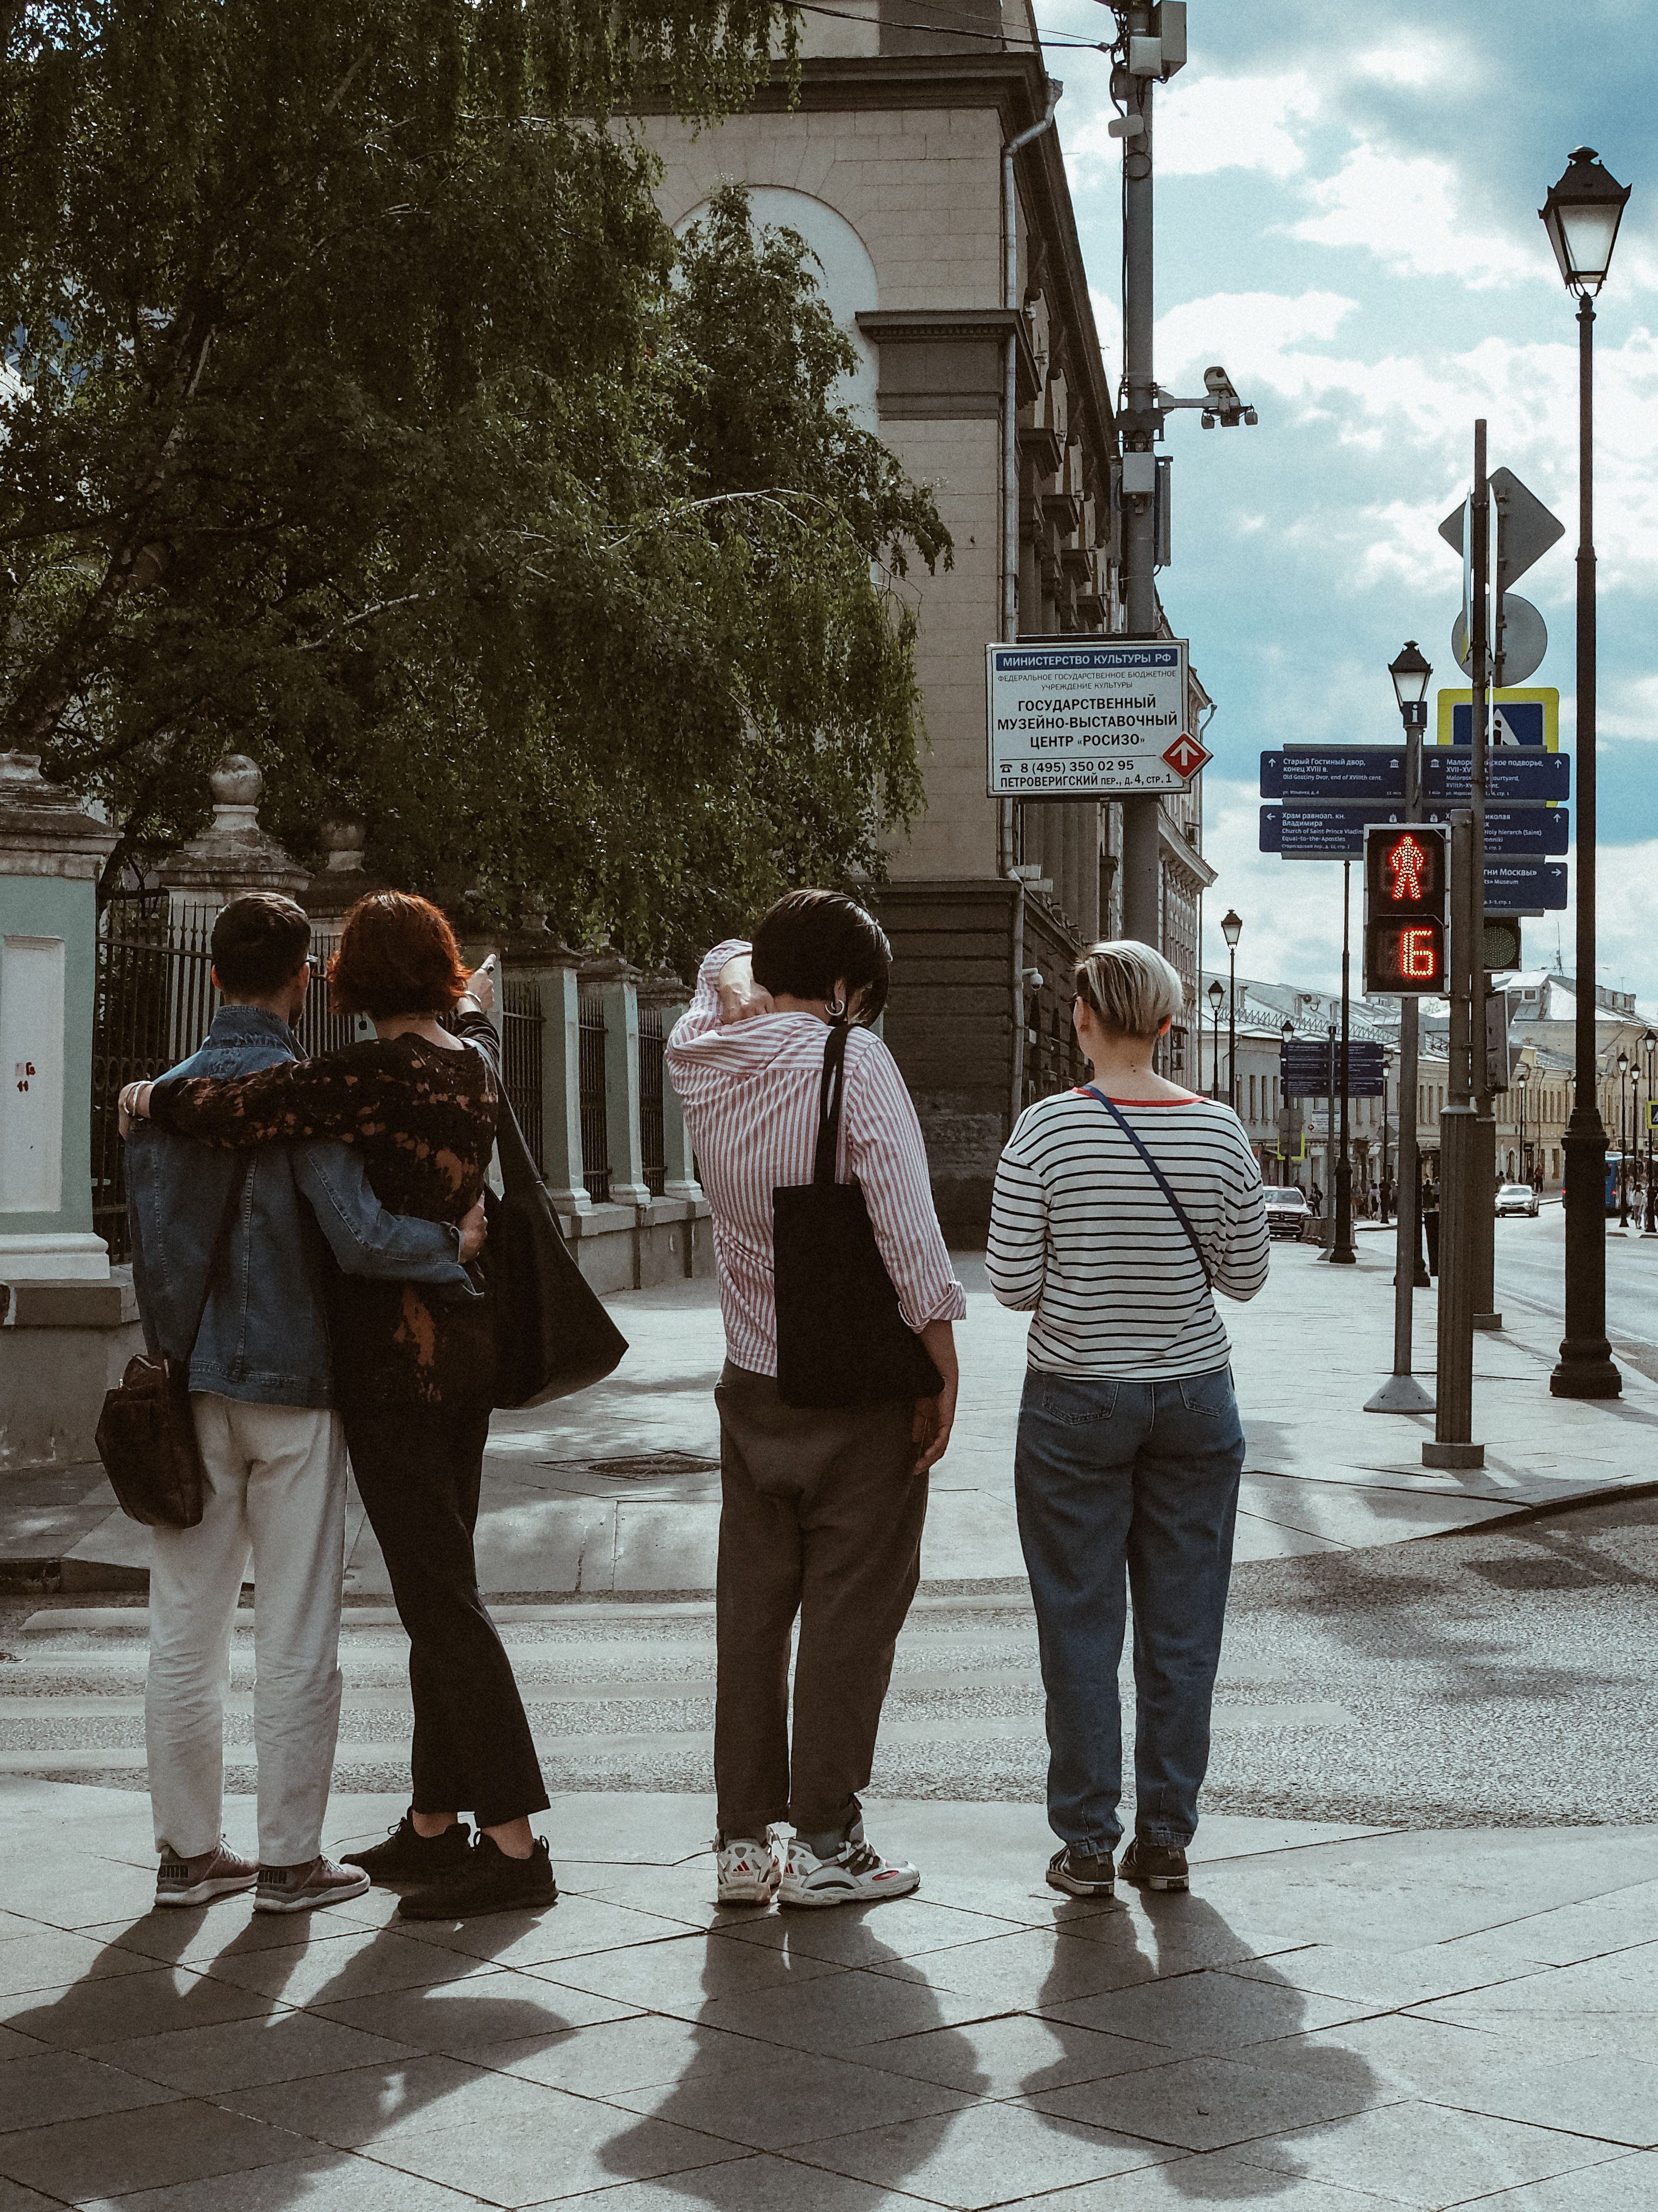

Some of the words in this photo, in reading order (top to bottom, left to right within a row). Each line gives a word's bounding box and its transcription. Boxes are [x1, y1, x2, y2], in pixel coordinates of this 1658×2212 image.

[1003, 655, 1090, 667] МИНИСТЕРСТВО
[1094, 653, 1151, 665] КУЛЬТУРЫ
[1155, 653, 1172, 662] РФ
[997, 674, 1052, 682] ФЕДЕРАЛЬНОЕ
[1055, 672, 1126, 681] ГОСУДАРСТВЕННОЕ
[1128, 670, 1176, 678] БЮДЖЕТНОЕ
[1041, 682, 1092, 691] УЧРЕЖДЕНИЕ
[1018, 693, 1156, 713] ГОСУДАРСТВЕННЫЙ
[997, 711, 1177, 730] МУЗЕЙНО-ВЫСТАВОЧНЫЙ
[1030, 736, 1074, 750] ЦЕНТР
[1077, 733, 1145, 746] «РОСИЗО»
[1021, 763, 1029, 773] 8
[1032, 762, 1066, 775] (495)
[1069, 761, 1094, 772] 350
[1097, 760, 1114, 771] 02
[1117, 760, 1134, 770] 95
[1283, 758, 1310, 766] Старый
[1508, 759, 1544, 767] подворье,
[1001, 772, 1098, 787] ПЕТРОВЕРИГСКИЙ
[1134, 773, 1144, 786] 4,
[1166, 773, 1172, 783] 1
[1282, 812, 1301, 820] Храм
[1282, 819, 1323, 828] Владимира
[1499, 868, 1537, 876] Москвы»
